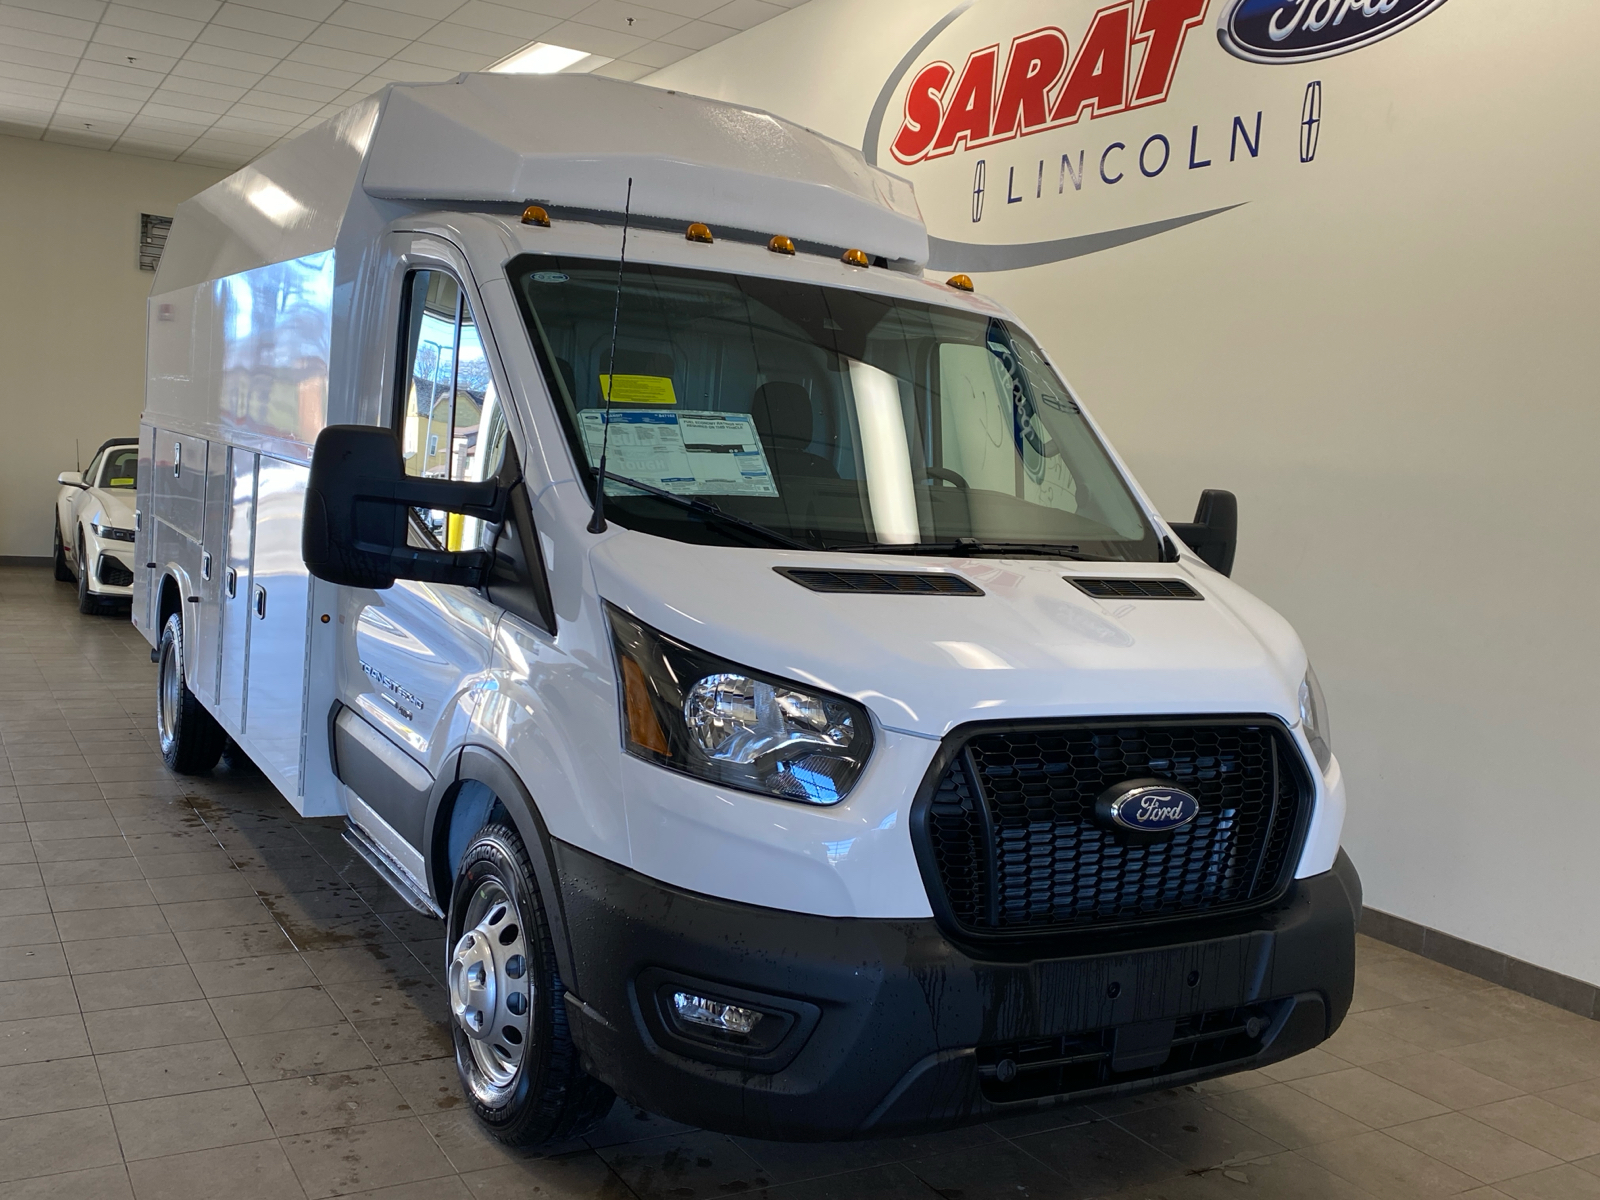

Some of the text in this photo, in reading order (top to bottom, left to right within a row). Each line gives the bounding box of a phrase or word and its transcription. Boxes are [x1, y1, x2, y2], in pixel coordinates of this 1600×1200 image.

[890, 0, 1209, 165] SARAT
[1007, 111, 1263, 204] LINCOLN
[1136, 795, 1183, 823] Ford
